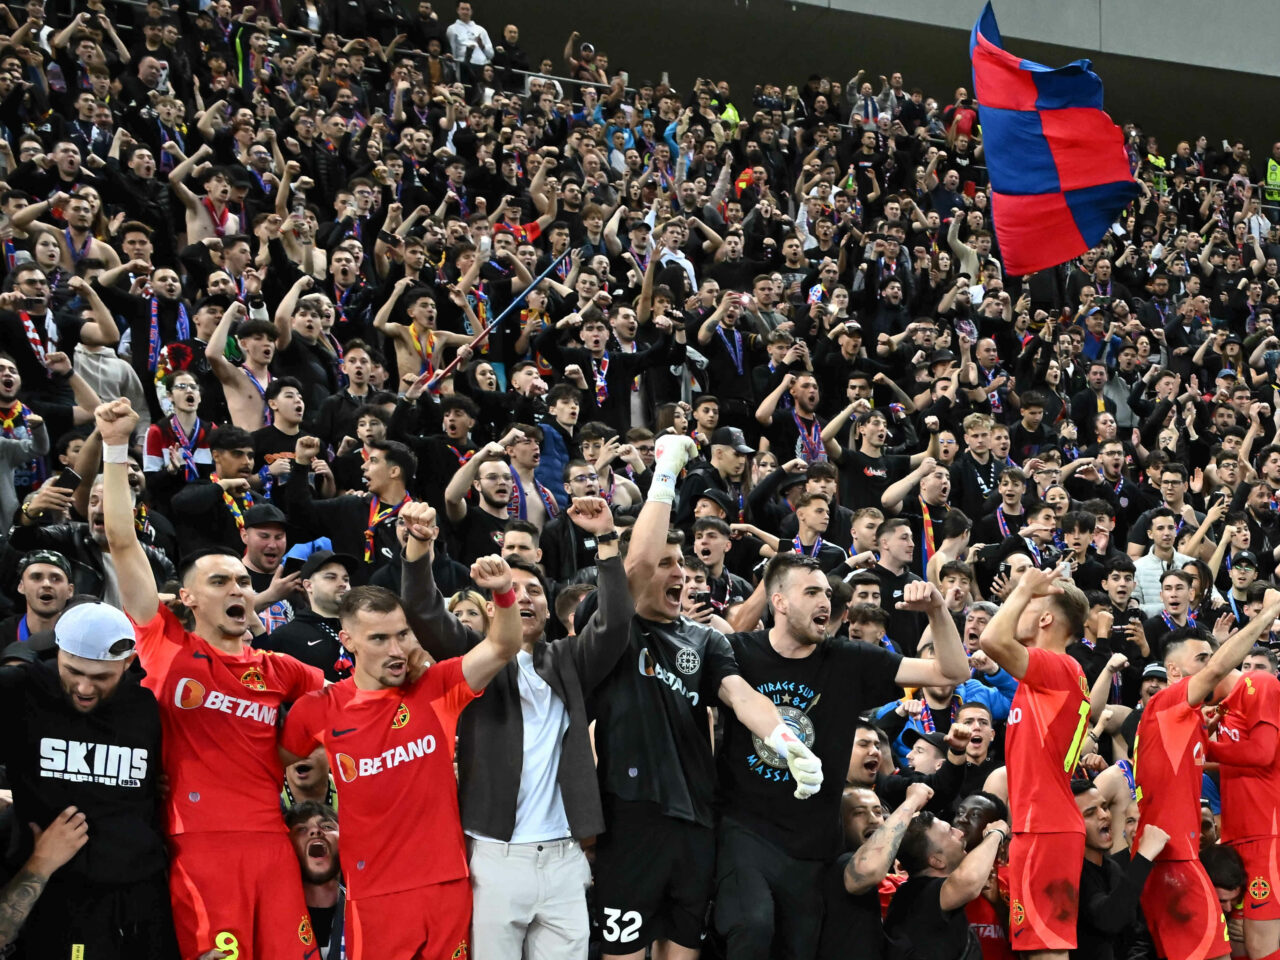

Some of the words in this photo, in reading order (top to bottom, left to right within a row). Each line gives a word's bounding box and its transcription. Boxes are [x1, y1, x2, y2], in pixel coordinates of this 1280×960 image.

[654, 662, 699, 707] BETANO
[757, 680, 796, 695] VIRAGE
[798, 684, 814, 698] SUD
[359, 734, 436, 777] BETANO
[602, 907, 643, 943] 32
